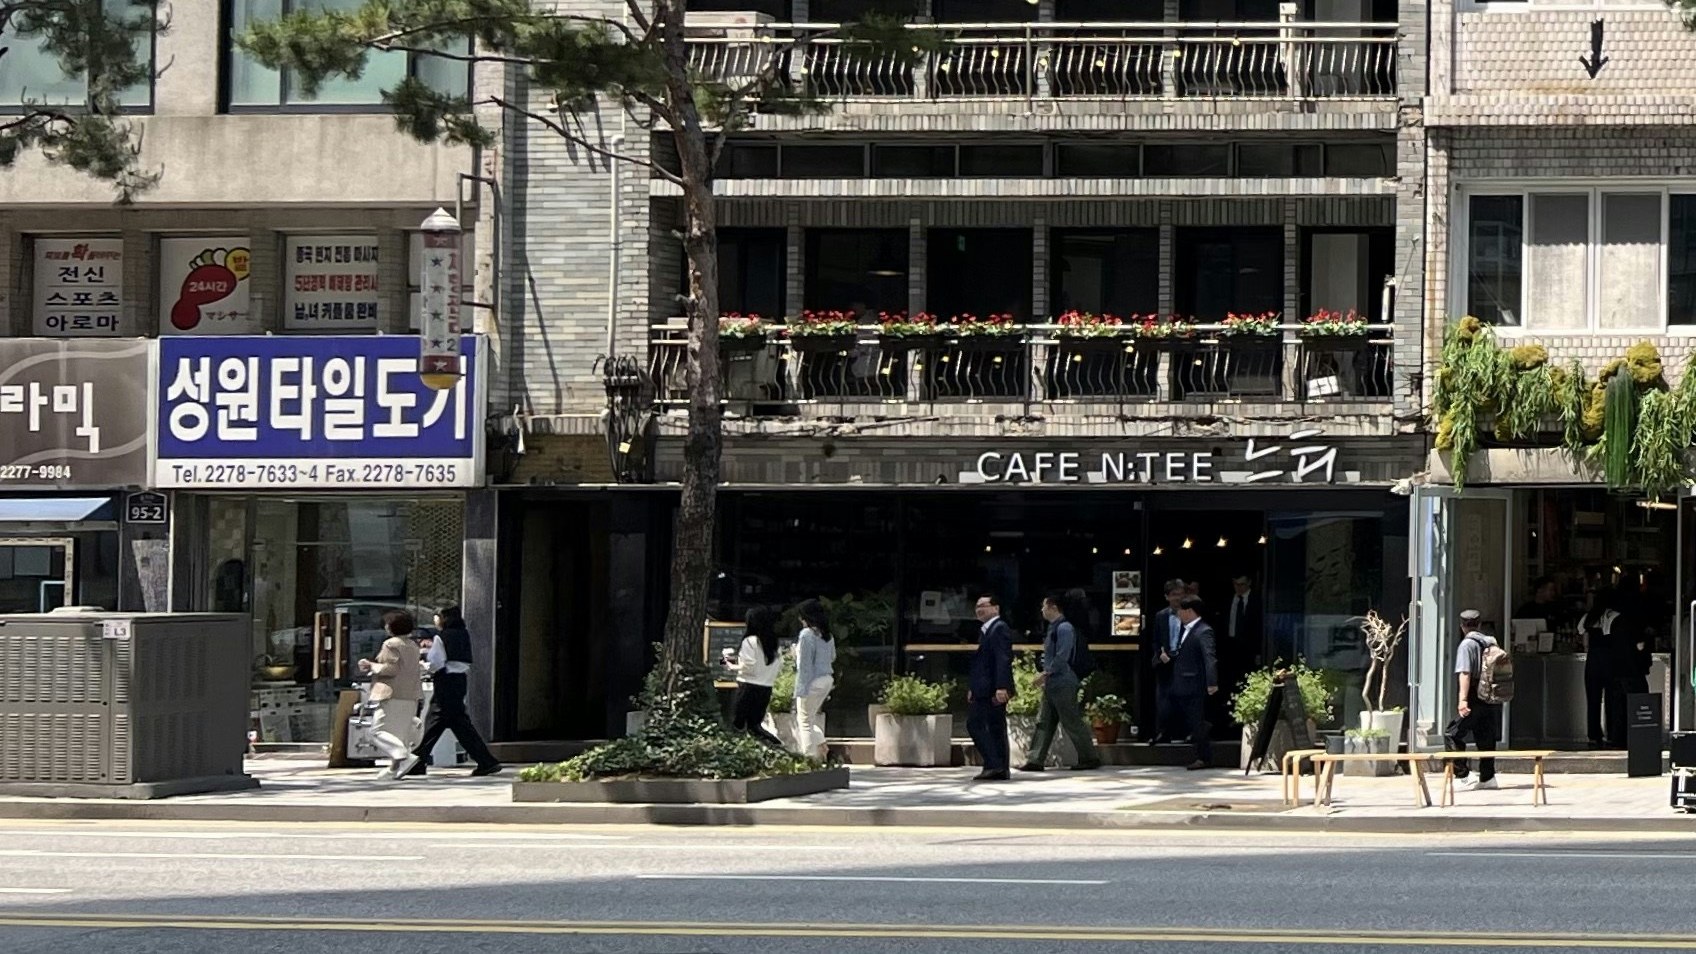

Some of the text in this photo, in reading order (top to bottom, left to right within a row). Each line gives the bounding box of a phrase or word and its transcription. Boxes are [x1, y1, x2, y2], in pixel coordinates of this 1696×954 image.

[58, 266, 104, 283] 전신
[189, 281, 227, 293] 24시간
[45, 291, 120, 306] 스포츠
[46, 315, 120, 332] 아로마
[0, 382, 100, 454] 라믹
[0, 465, 70, 479] 2277-9984
[976, 451, 1080, 482] CAFE
[1101, 451, 1214, 482] N:TEE
[131, 506, 161, 520] 95-2
